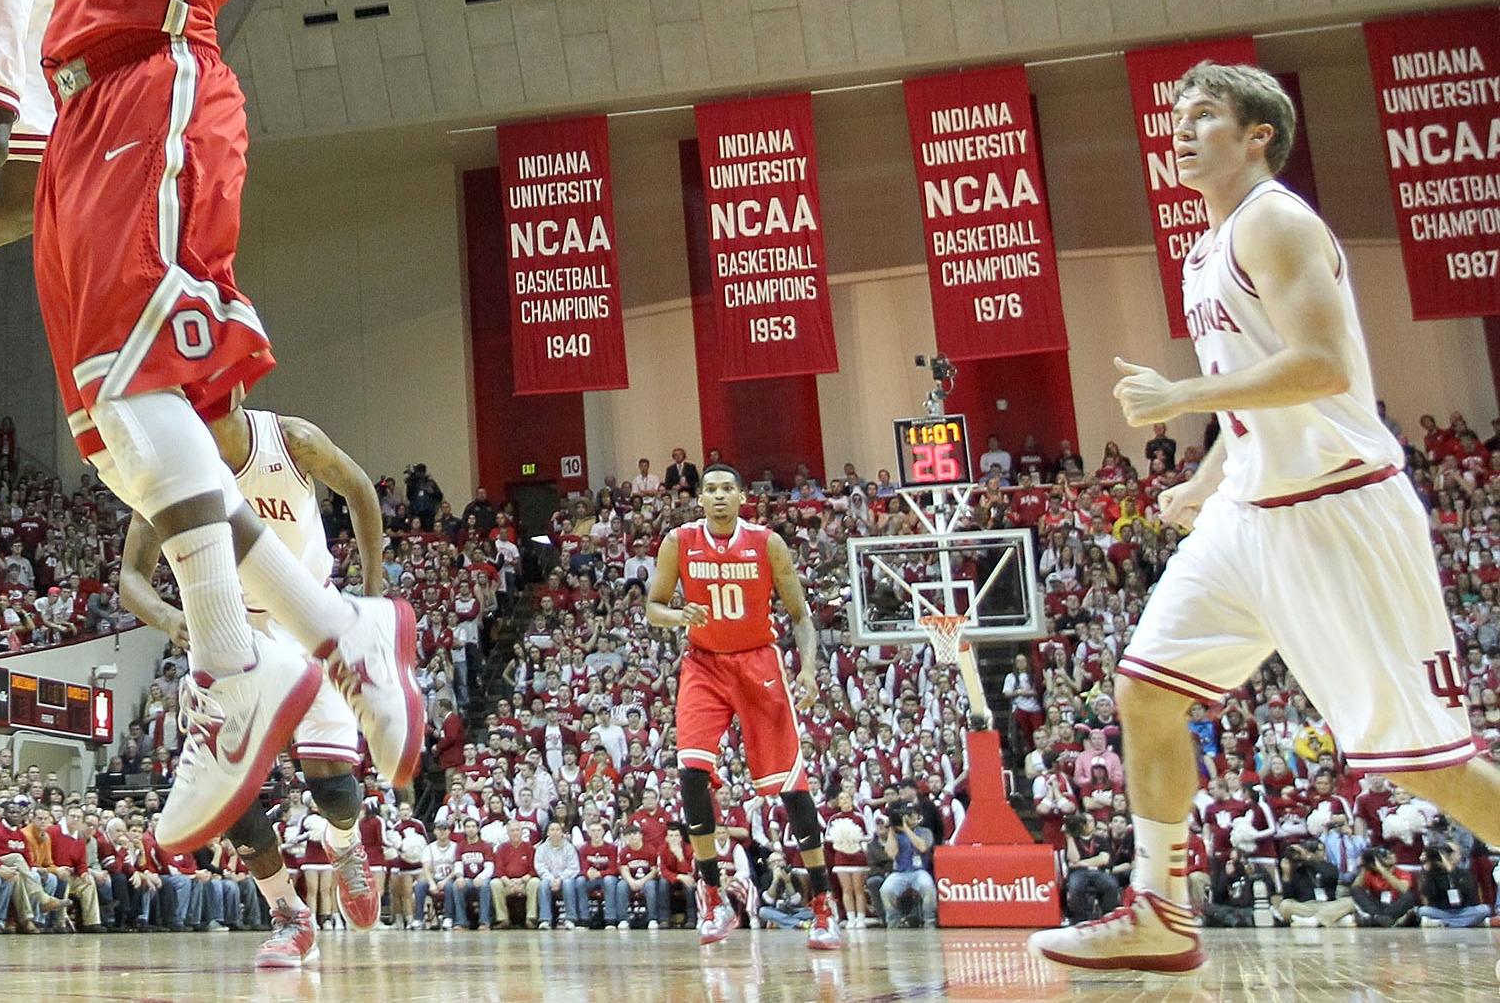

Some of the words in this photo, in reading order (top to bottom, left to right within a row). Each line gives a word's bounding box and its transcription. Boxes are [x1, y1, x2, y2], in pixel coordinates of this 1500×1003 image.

[1391, 46, 1485, 81] INDIANA
[1382, 75, 1500, 114] UNIVERSITY
[931, 102, 1013, 135] INDIANA
[718, 129, 794, 159] INDIANA
[921, 129, 1028, 166] UNIVERSITY
[518, 150, 591, 180] INDIANA
[709, 157, 807, 189] UNIVERSITY
[509, 178, 603, 210] UNIVERSITY
[923, 168, 1040, 219] NCAA
[1399, 174, 1500, 209] BASKETBA
[711, 194, 817, 240] NCAA
[510, 215, 611, 258] NCAA
[932, 220, 1041, 257] BASKETBALL
[717, 245, 817, 277] BASKETBALL
[941, 251, 1041, 287] CHAMPIONS
[1446, 250, 1499, 280] 1987
[515, 265, 611, 295] BASKETBALL
[724, 276, 817, 308] CHAMPIONS
[521, 295, 609, 324] CHAMPIONS
[973, 292, 1023, 323] 1976
[749, 315, 797, 343] 1953
[546, 333, 591, 359] 1940
[909, 423, 961, 444] 11:07
[565, 458, 580, 474] 10
[912, 444, 959, 483] 26
[689, 561, 719, 579] OHIO
[720, 562, 759, 580] STATE
[706, 582, 744, 620] 10
[937, 876, 1050, 902] Smithville
